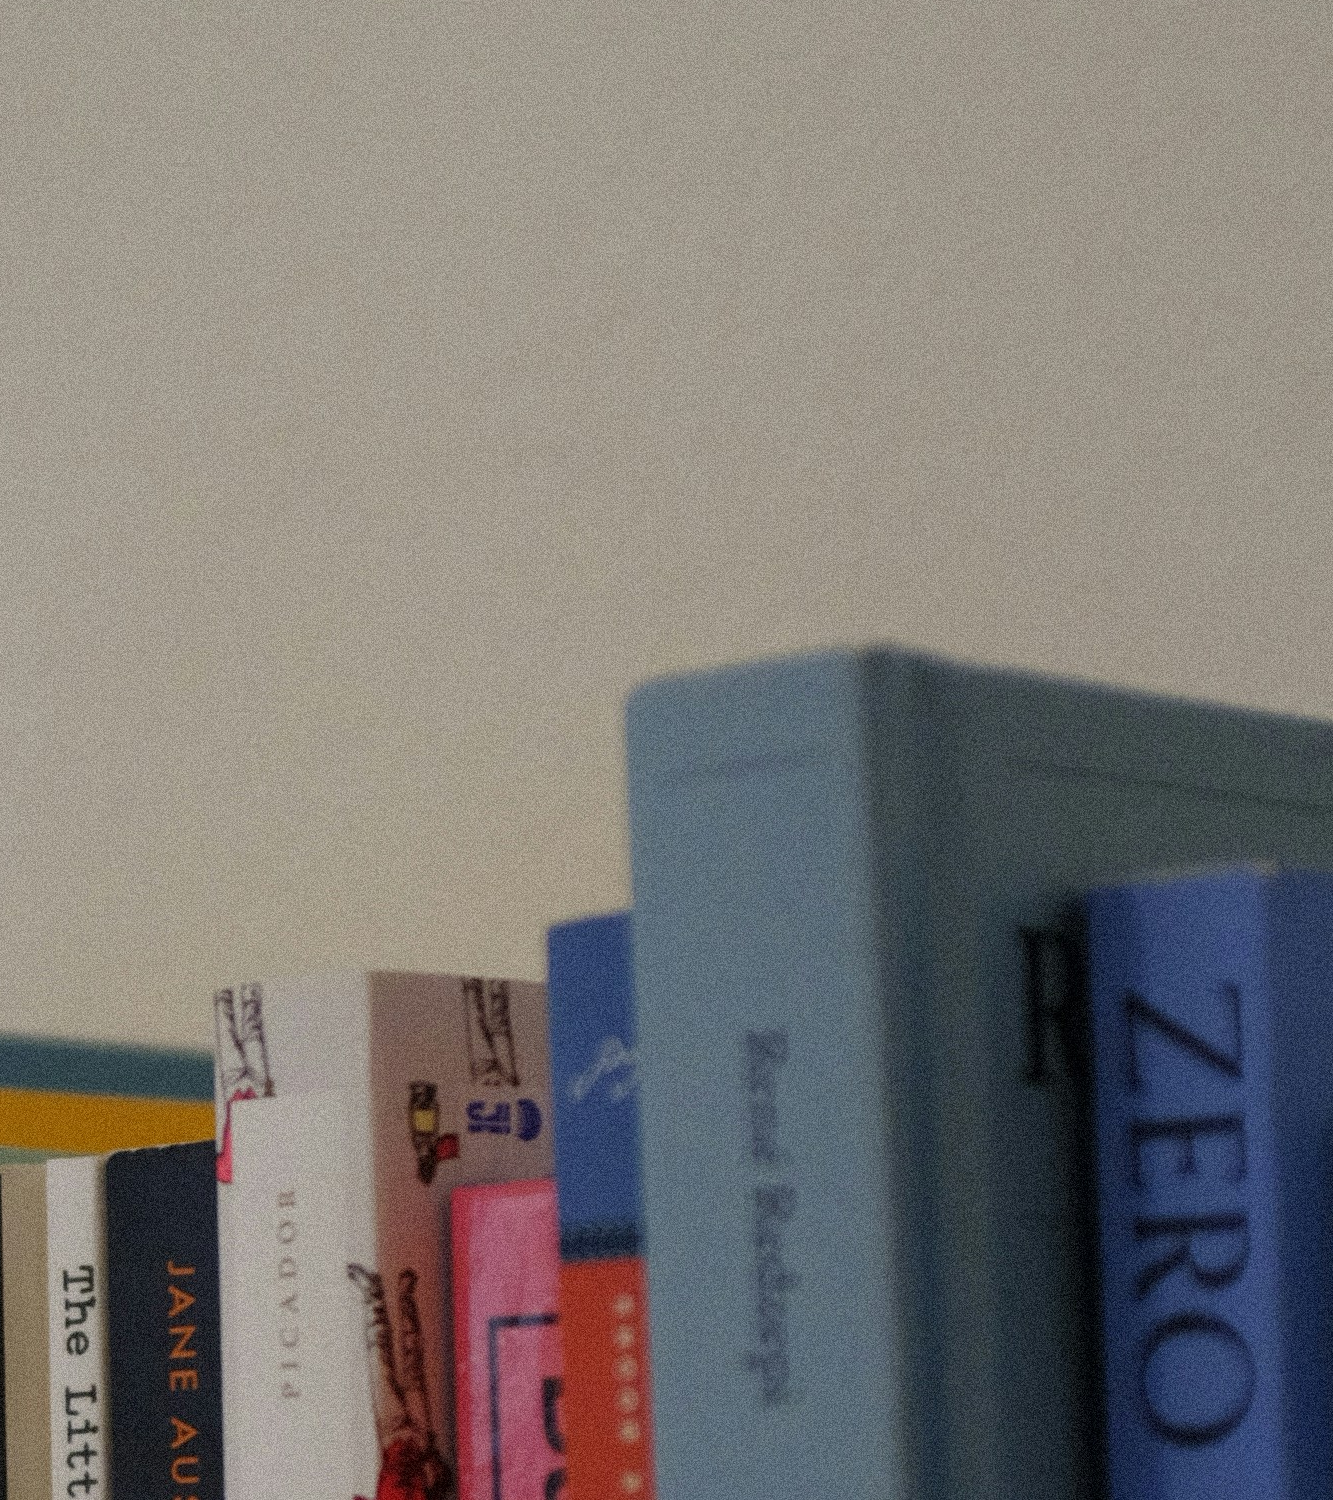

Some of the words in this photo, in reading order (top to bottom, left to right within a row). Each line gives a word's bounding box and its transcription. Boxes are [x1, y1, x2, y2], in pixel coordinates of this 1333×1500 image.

[276, 1189, 300, 1401] PICADOR
[1122, 981, 1257, 1451] ZERO
[63, 1264, 96, 1357] The
[167, 1260, 200, 1392] JANE
